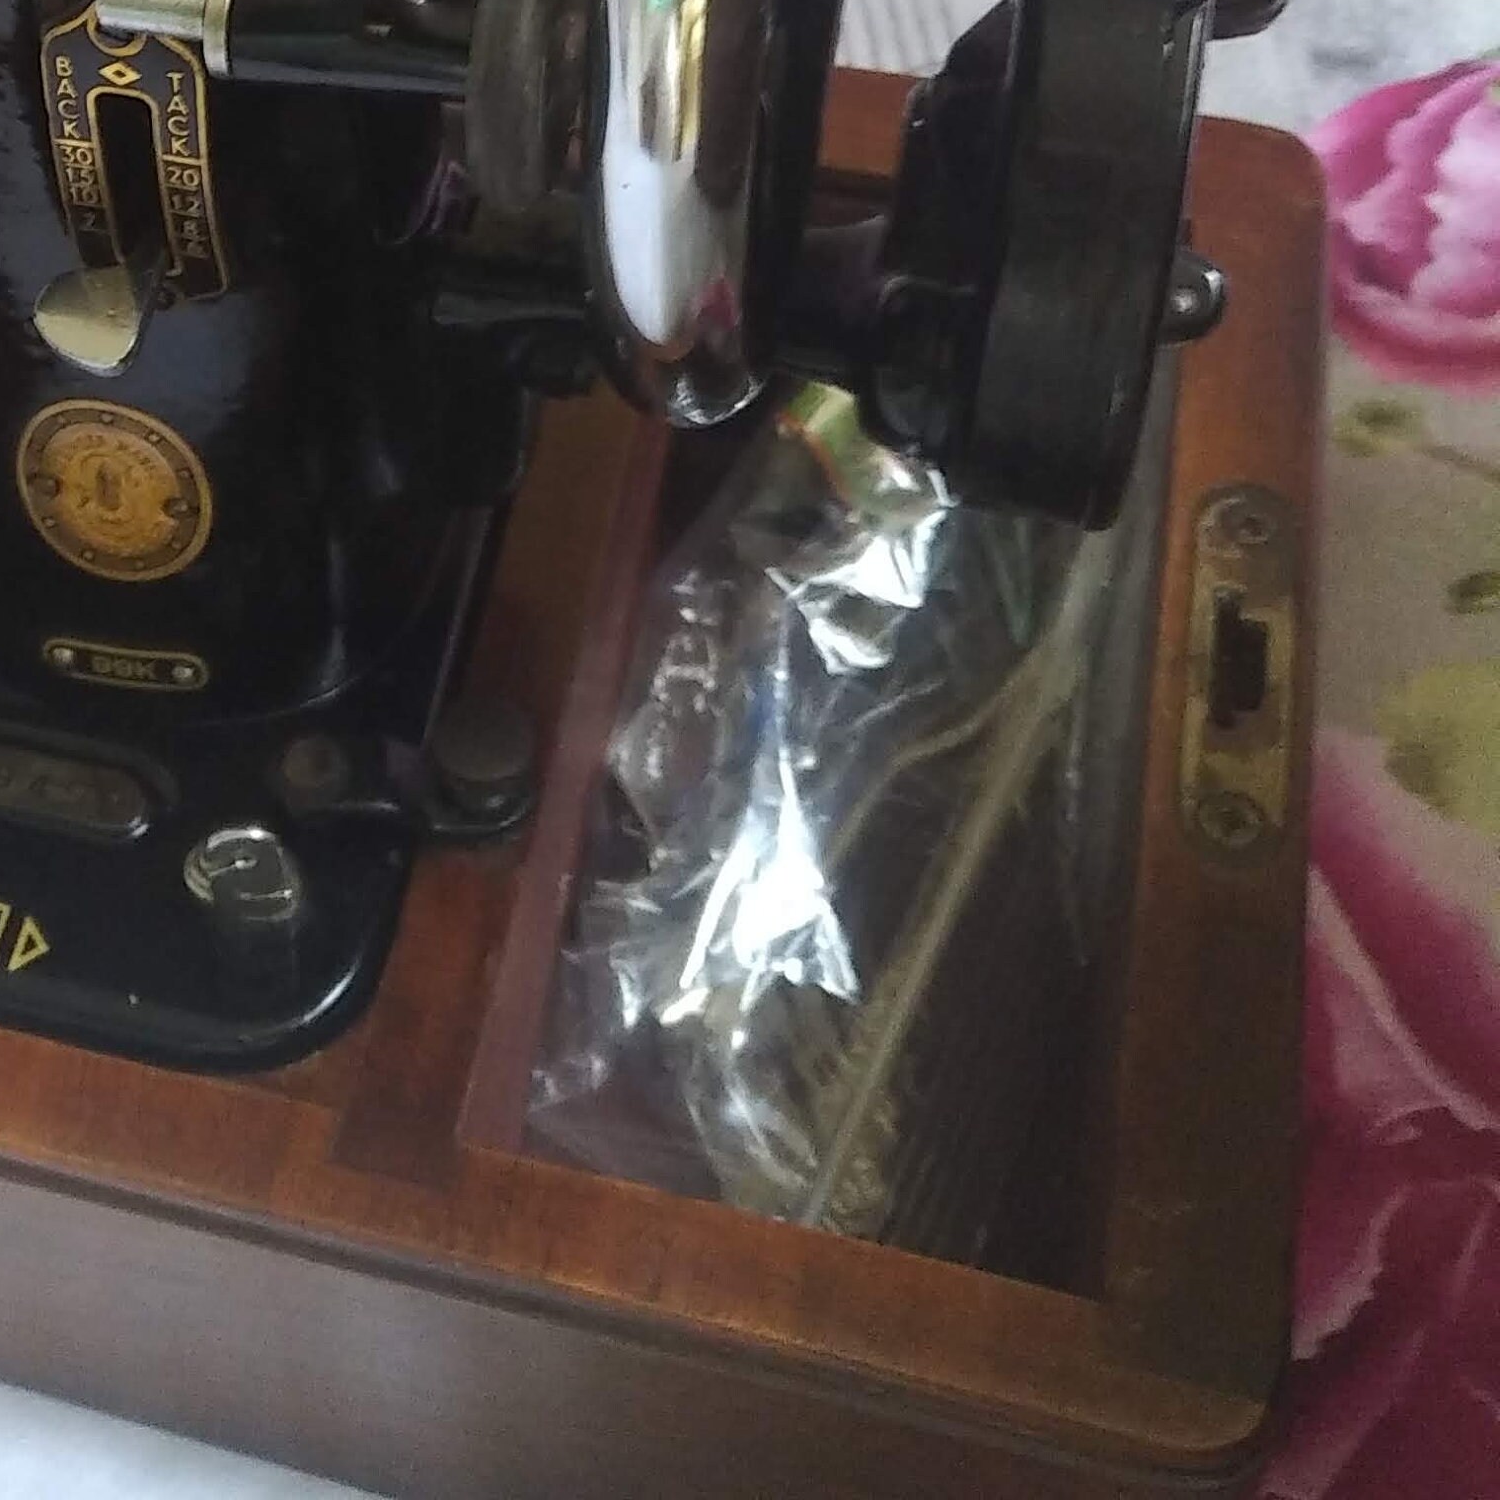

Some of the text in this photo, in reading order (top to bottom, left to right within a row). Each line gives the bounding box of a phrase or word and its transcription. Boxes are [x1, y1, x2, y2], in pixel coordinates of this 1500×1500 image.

[54, 55, 82, 140] BACK
[165, 71, 191, 157] TACK
[60, 145, 93, 166] 30
[166, 164, 200, 187] 20
